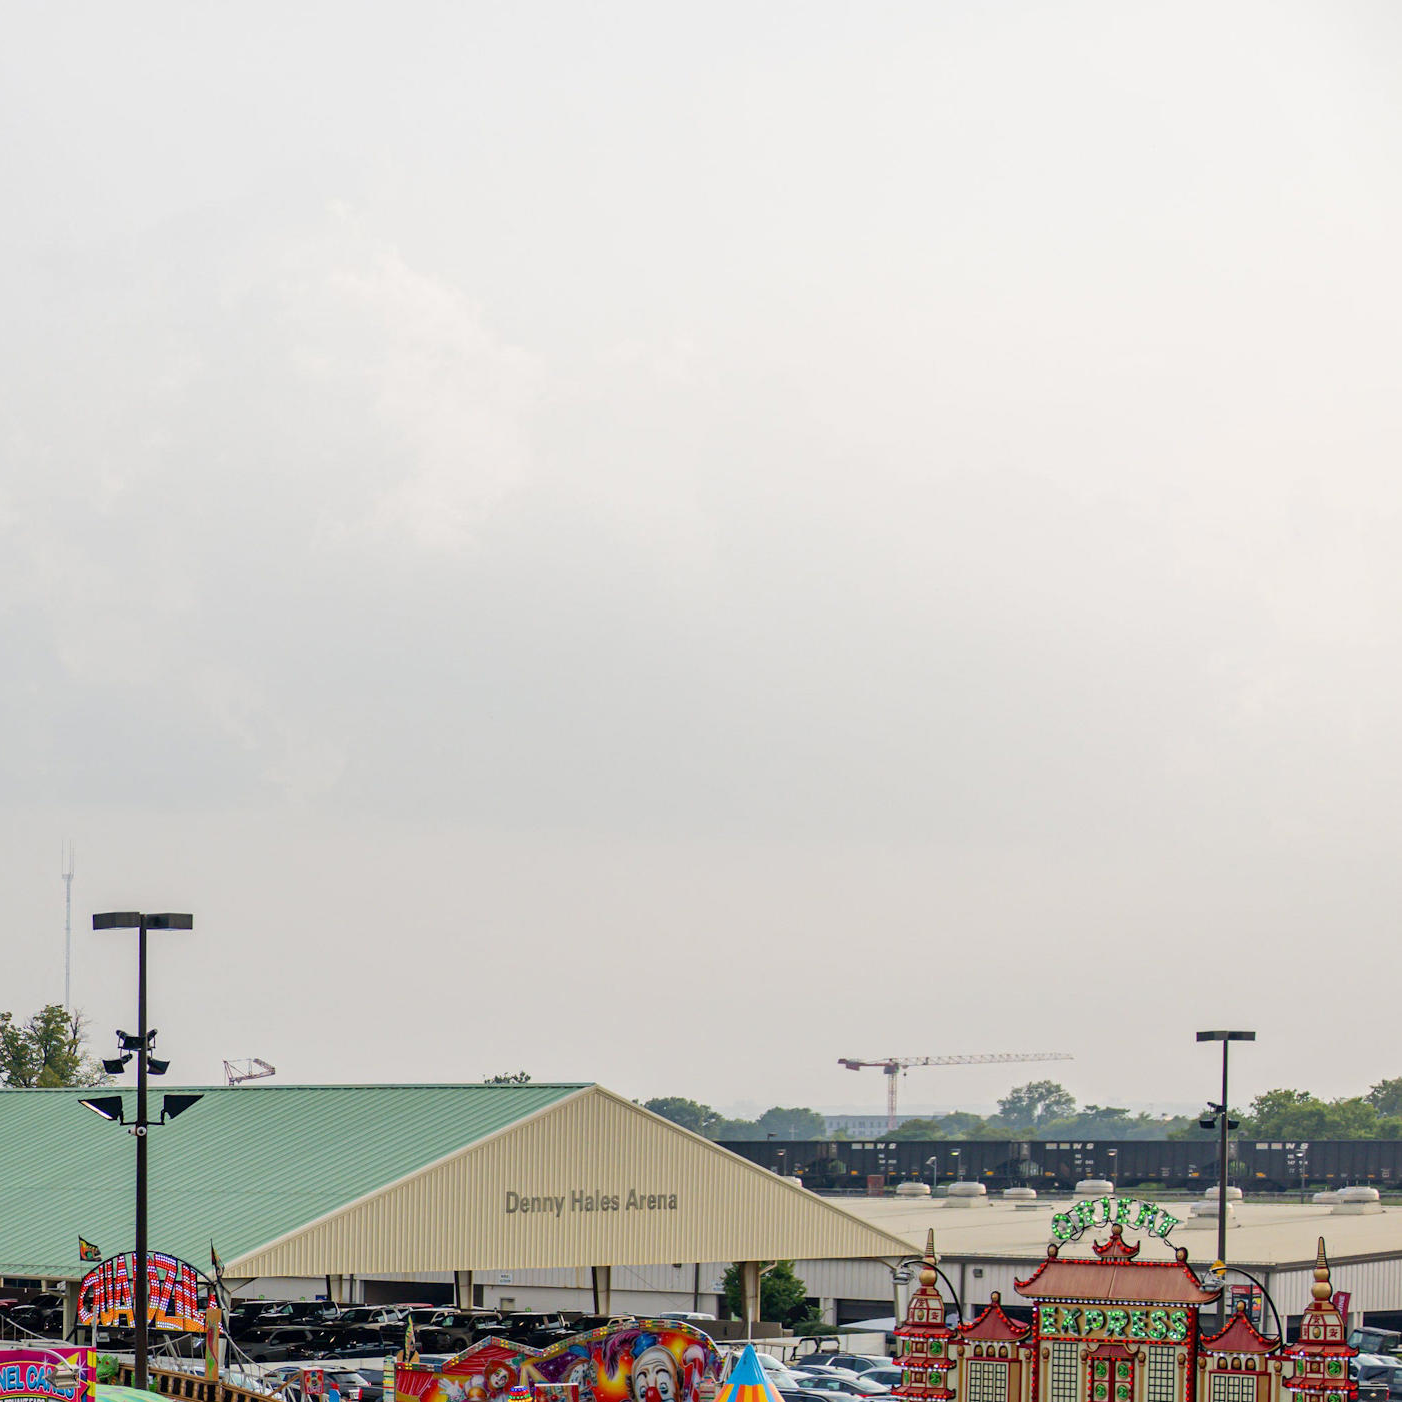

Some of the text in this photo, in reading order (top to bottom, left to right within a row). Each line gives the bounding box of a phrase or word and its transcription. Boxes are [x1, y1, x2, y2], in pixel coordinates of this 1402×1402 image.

[505, 1189, 679, 1218] Denny Hales Arena
[1051, 1197, 1184, 1239] ORIENT
[1040, 1305, 1188, 1341] EXPRESS
